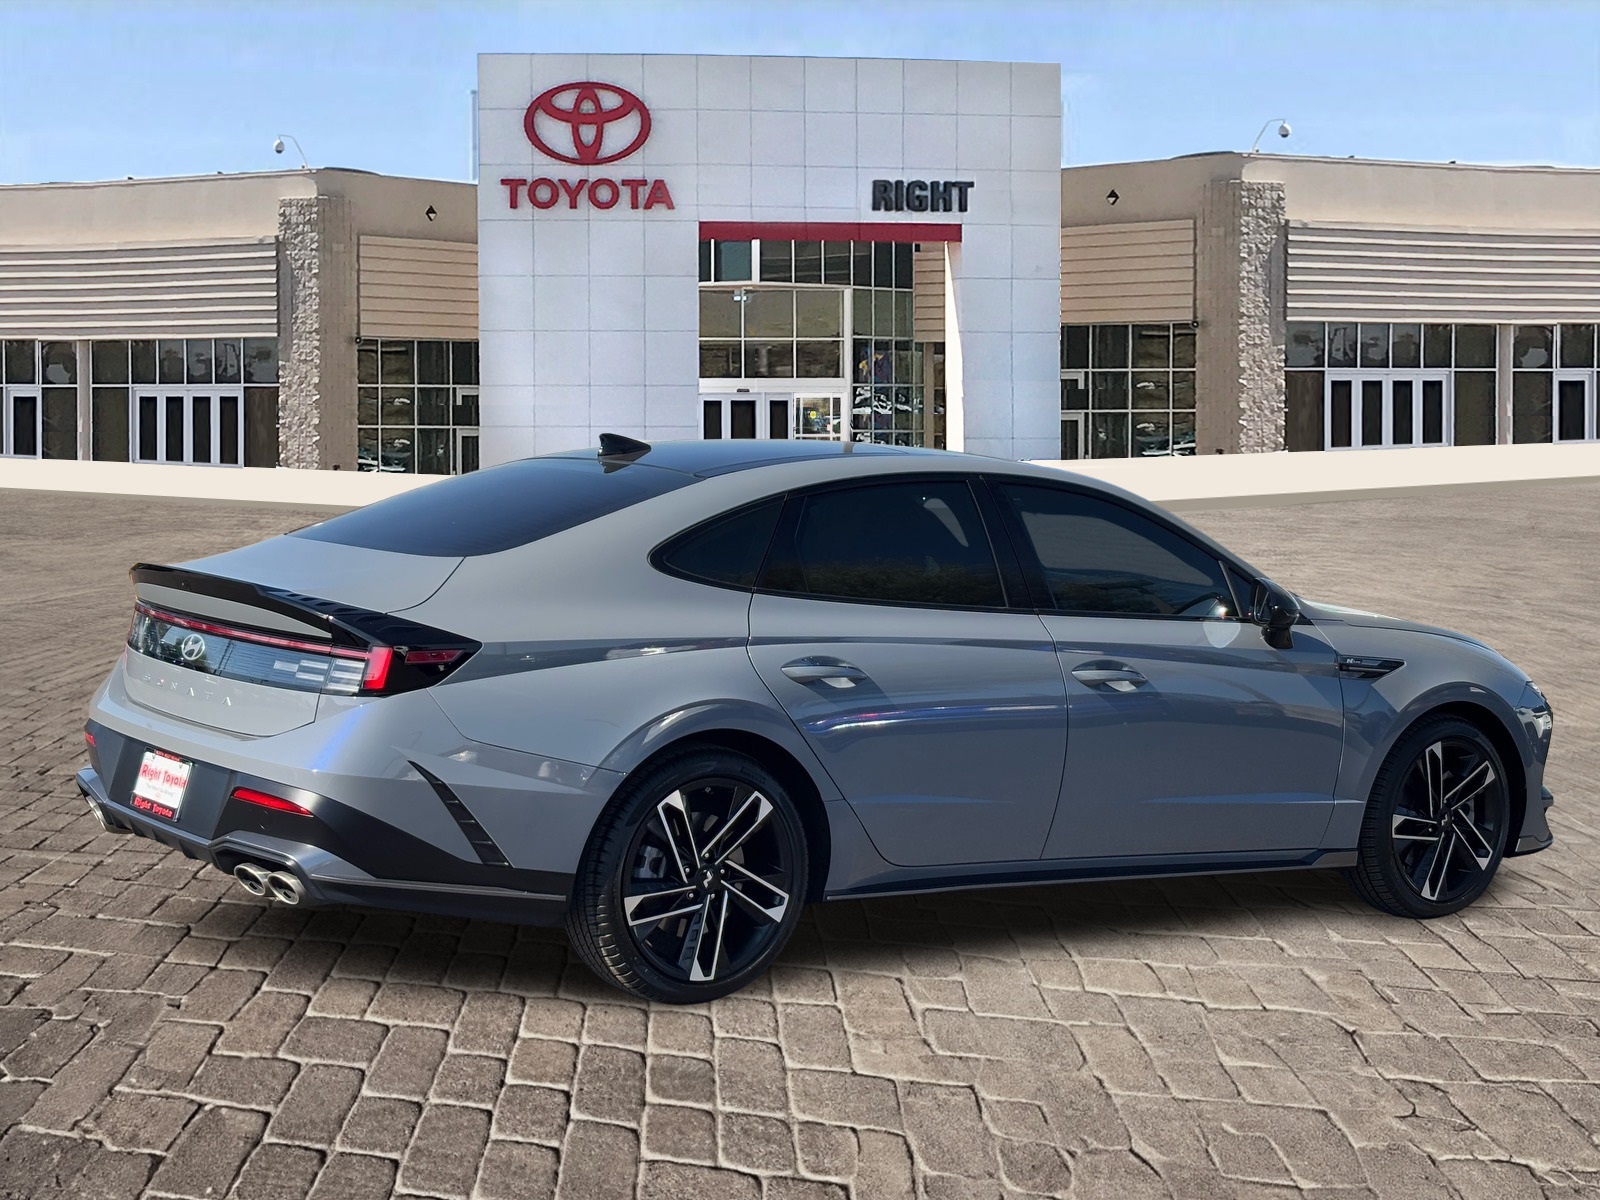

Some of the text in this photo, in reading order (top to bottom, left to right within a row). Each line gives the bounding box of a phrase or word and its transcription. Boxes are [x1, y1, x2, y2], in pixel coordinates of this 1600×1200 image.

[500, 178, 675, 210] TOYOTA
[872, 180, 974, 212] RIGHT
[141, 764, 186, 787] Right Toyota
[134, 797, 173, 817] Right Toyota
